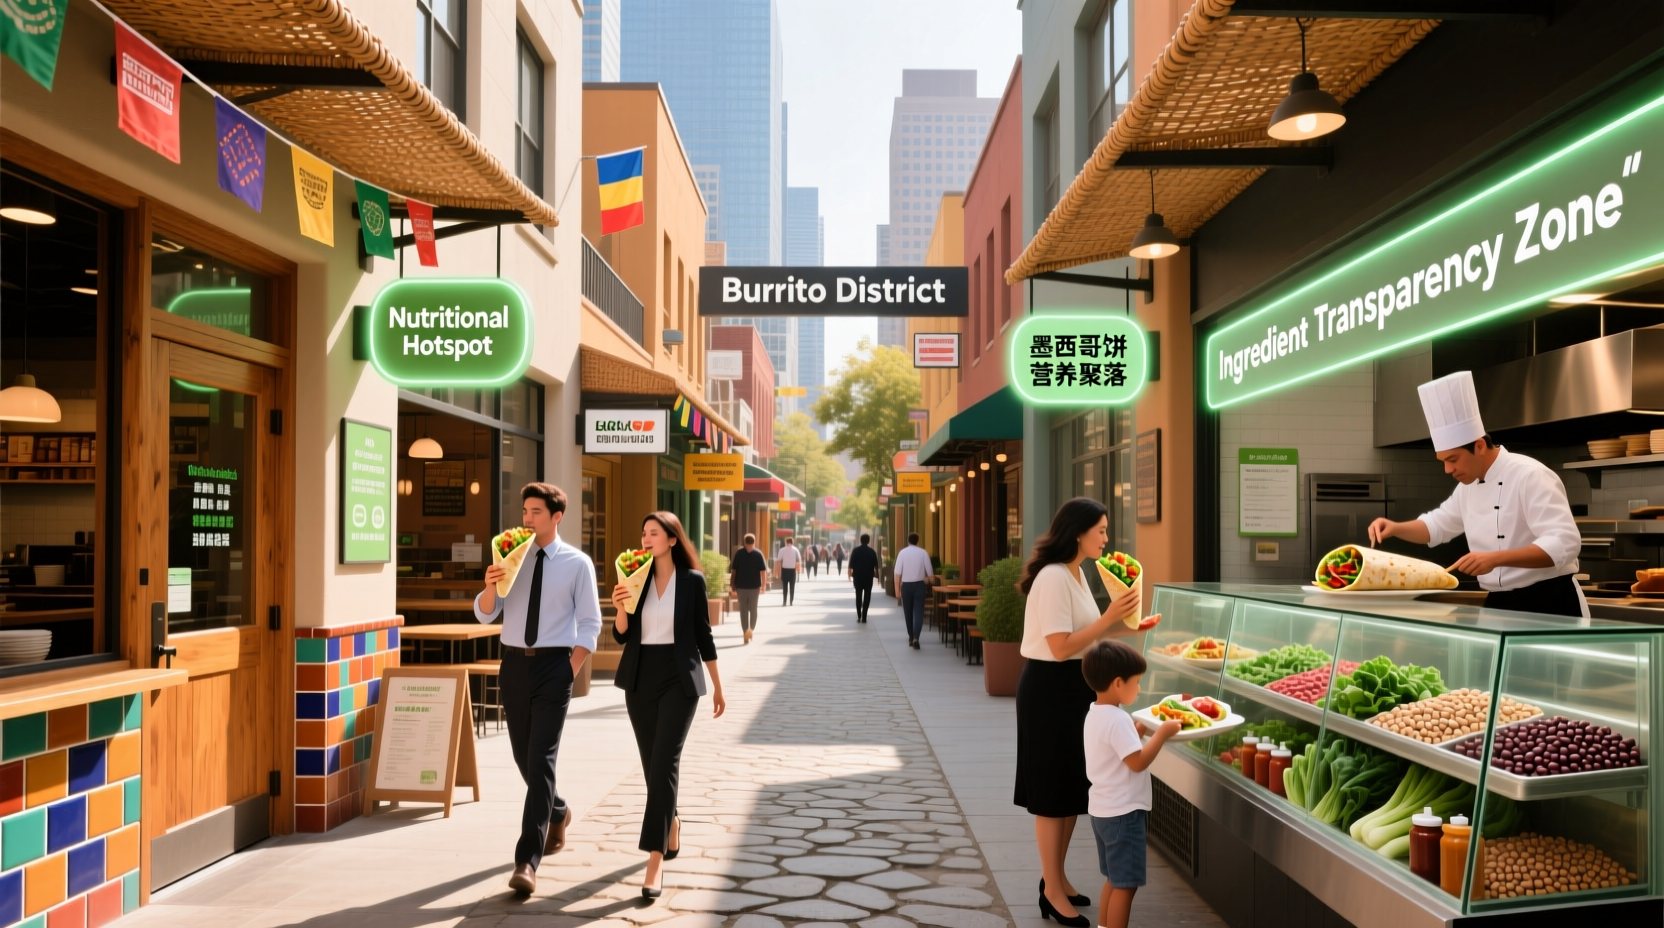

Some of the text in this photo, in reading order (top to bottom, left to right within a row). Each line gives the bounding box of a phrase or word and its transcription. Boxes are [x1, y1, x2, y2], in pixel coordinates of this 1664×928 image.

[722, 275, 946, 304] Burrito District
[389, 304, 509, 329] Nutritional
[1219, 316, 1309, 385] Ingredient
[1313, 232, 1504, 342] Transparency
[403, 334, 493, 362] Hotspot
[1029, 334, 1128, 359] 墨西哥饼
[1029, 361, 1128, 387] 营养聚落
